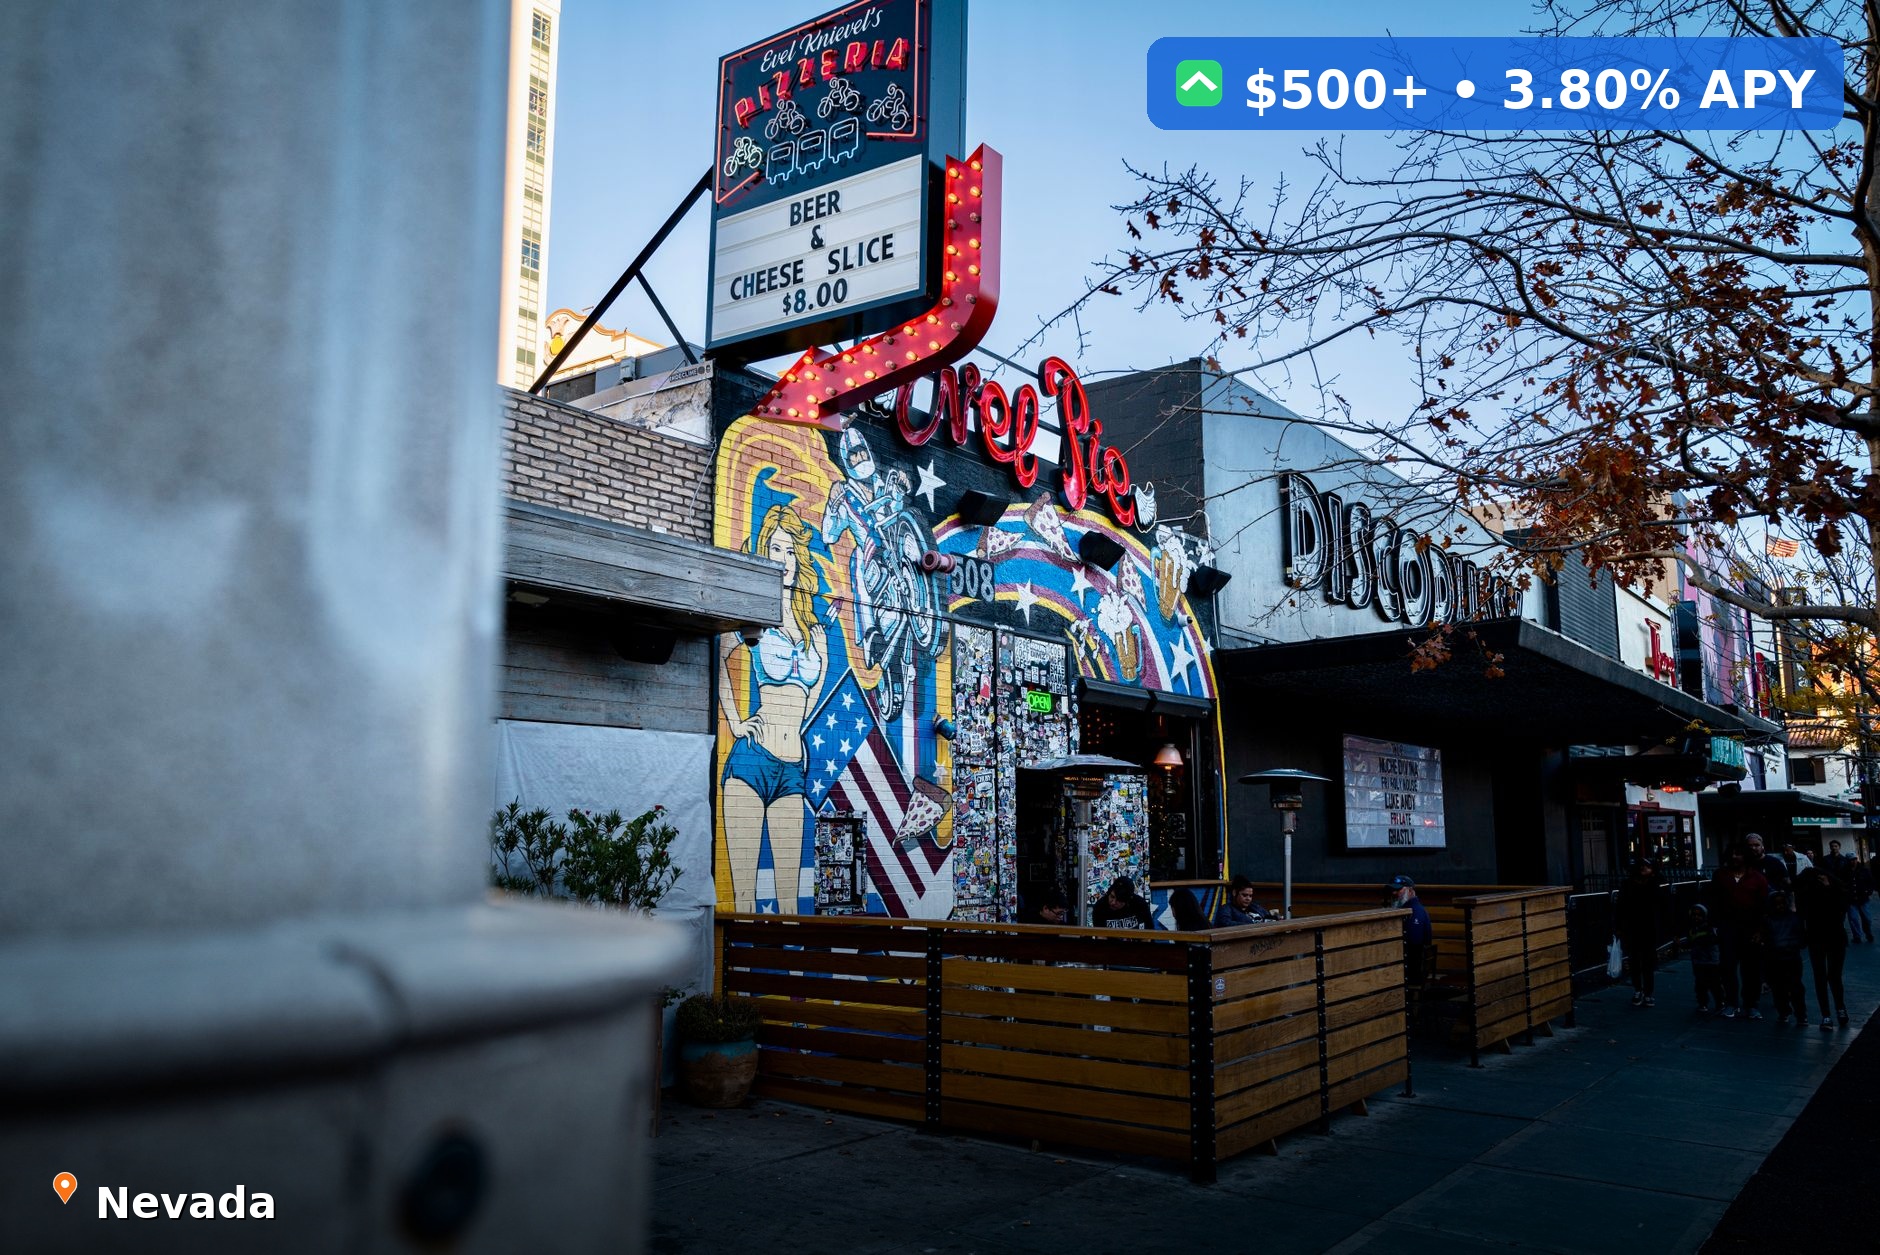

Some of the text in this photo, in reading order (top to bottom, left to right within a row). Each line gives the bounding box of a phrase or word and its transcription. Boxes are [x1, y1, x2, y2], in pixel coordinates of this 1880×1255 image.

[760, 7, 883, 73] Evel Knievel's
[735, 37, 910, 128] PIZZERIA
[789, 190, 841, 227] BEER
[810, 224, 825, 250] &
[730, 233, 894, 301] CHEESE SLICE
[782, 278, 848, 316] $8.00
[1038, 356, 1135, 527] Pie
[951, 556, 995, 603] 508
[1027, 693, 1050, 711] OPEN
[1388, 828, 1415, 845] GHASTLY
